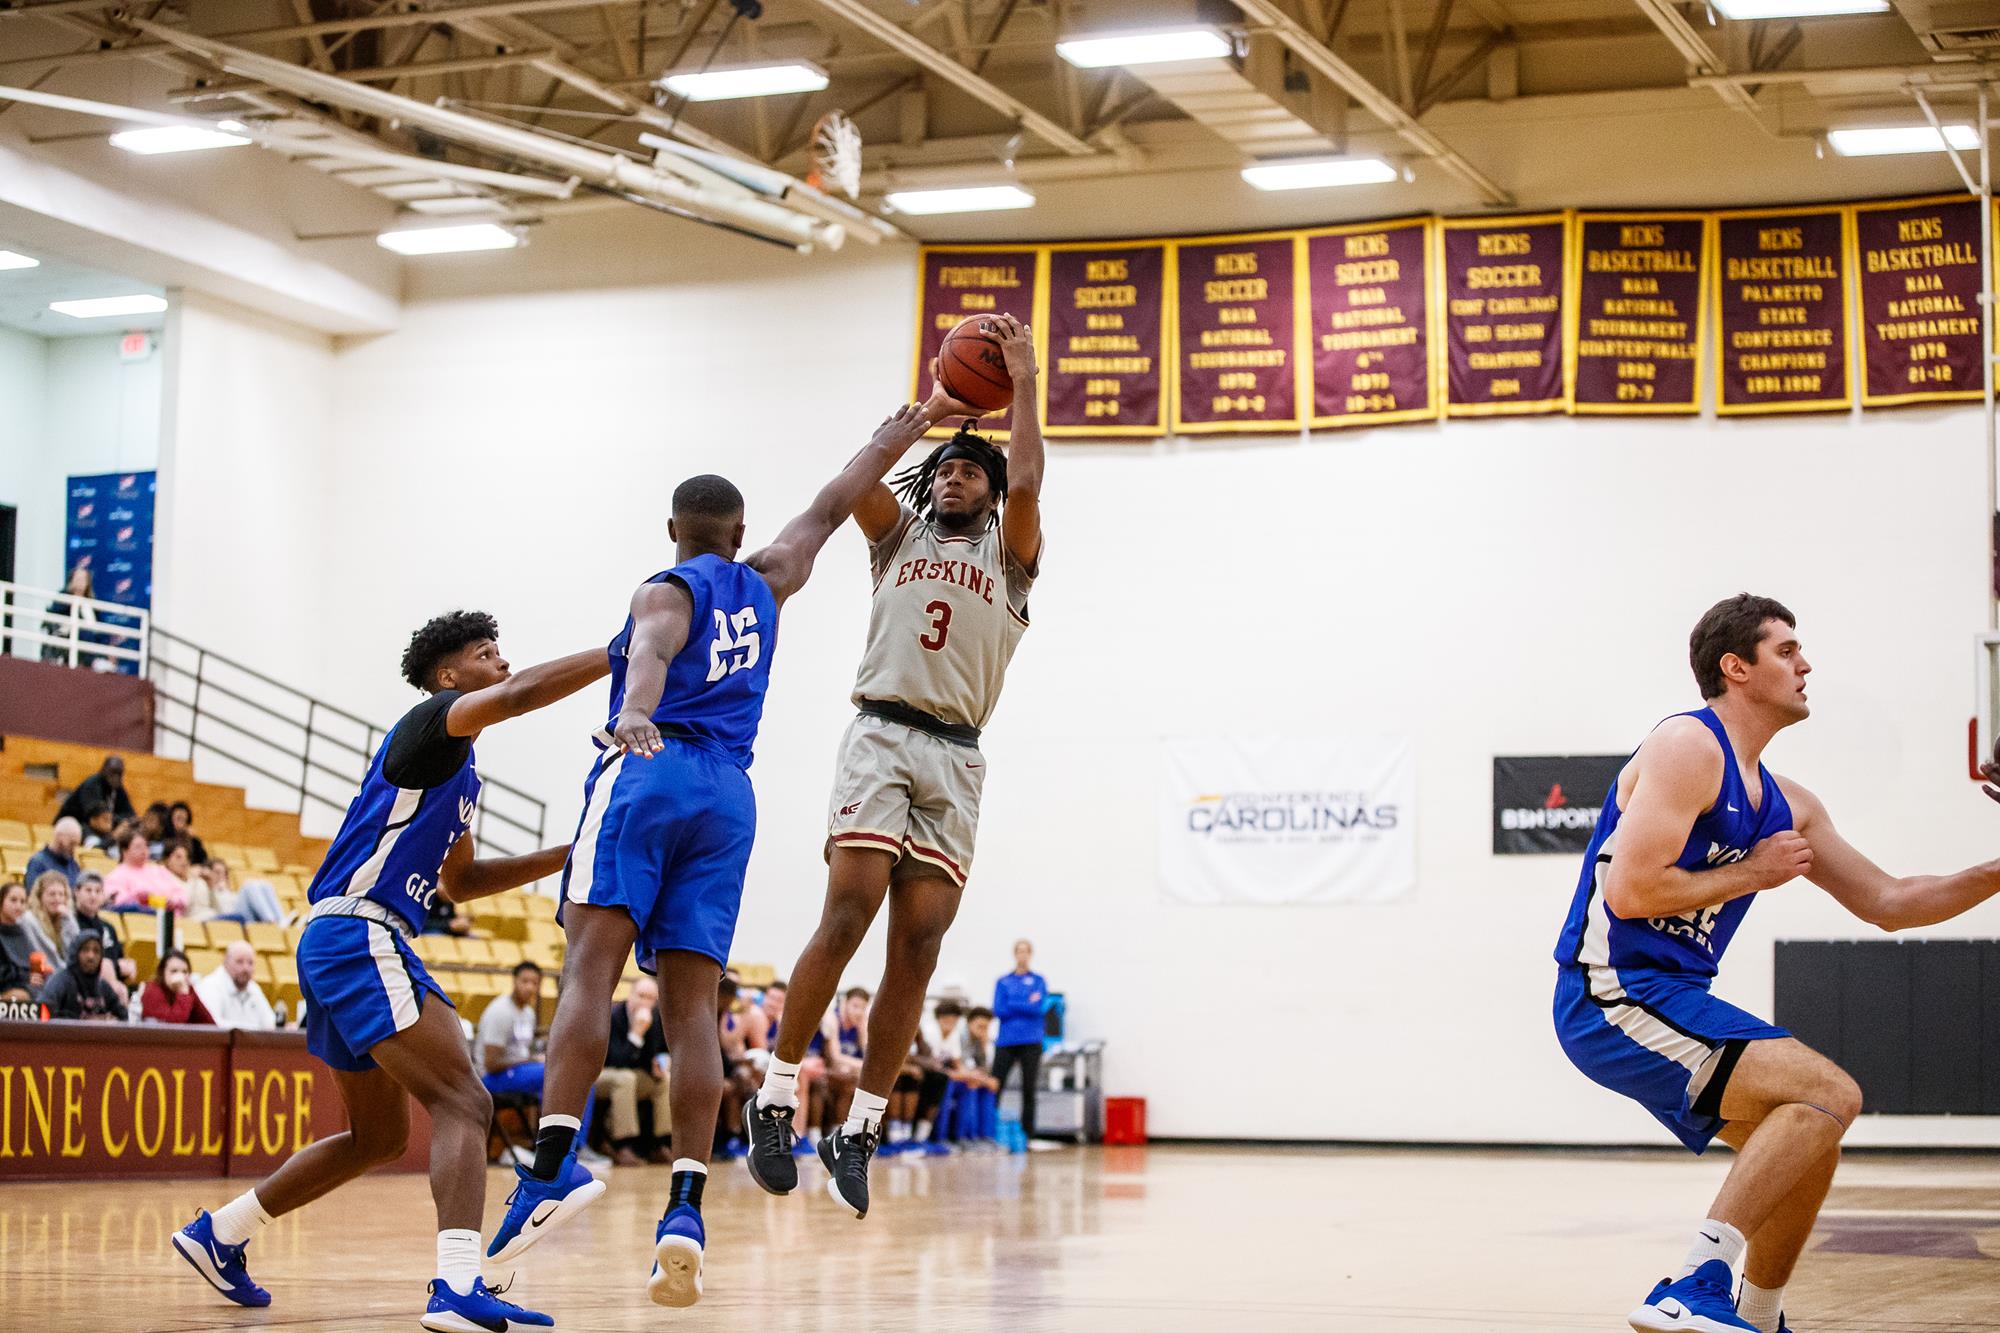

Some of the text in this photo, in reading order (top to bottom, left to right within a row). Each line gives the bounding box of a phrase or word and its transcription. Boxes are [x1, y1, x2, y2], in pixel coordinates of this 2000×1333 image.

[1588, 251, 1695, 272] BASKETBALL
[1728, 257, 1837, 280] BASKETBALL
[1868, 243, 1976, 272] BASKETBALL
[1335, 259, 1399, 286] SOCCER
[1467, 265, 1541, 289] SOCCER
[1906, 275, 1943, 292] NAIA
[1074, 285, 1136, 308] SOCCER
[1205, 278, 1268, 302] SOCCER
[1743, 285, 1822, 301] PALMETTO
[1604, 300, 1676, 316] NATIONAL
[1760, 308, 1806, 324] STATE
[1889, 296, 1964, 317] NATIONAL
[1321, 327, 1417, 351] TOURNAMENT
[1590, 320, 1686, 337] TOURNAMENT
[1733, 329, 1832, 347] CONFERENCE
[1877, 318, 1978, 340] TOURNAMENT
[1058, 357, 1150, 373] TOURNAMENT
[1191, 350, 1286, 367] TOURNAMENT
[1469, 351, 1541, 369] CHAMPIONS
[1740, 353, 1826, 370] CHAMPIONS
[895, 558, 995, 605] ERSKINE
[919, 600, 953, 652] 3
[706, 607, 761, 681] 25
[1189, 805, 1399, 834] CAROLINAS
[101, 1065, 315, 1158] COLLEGE
